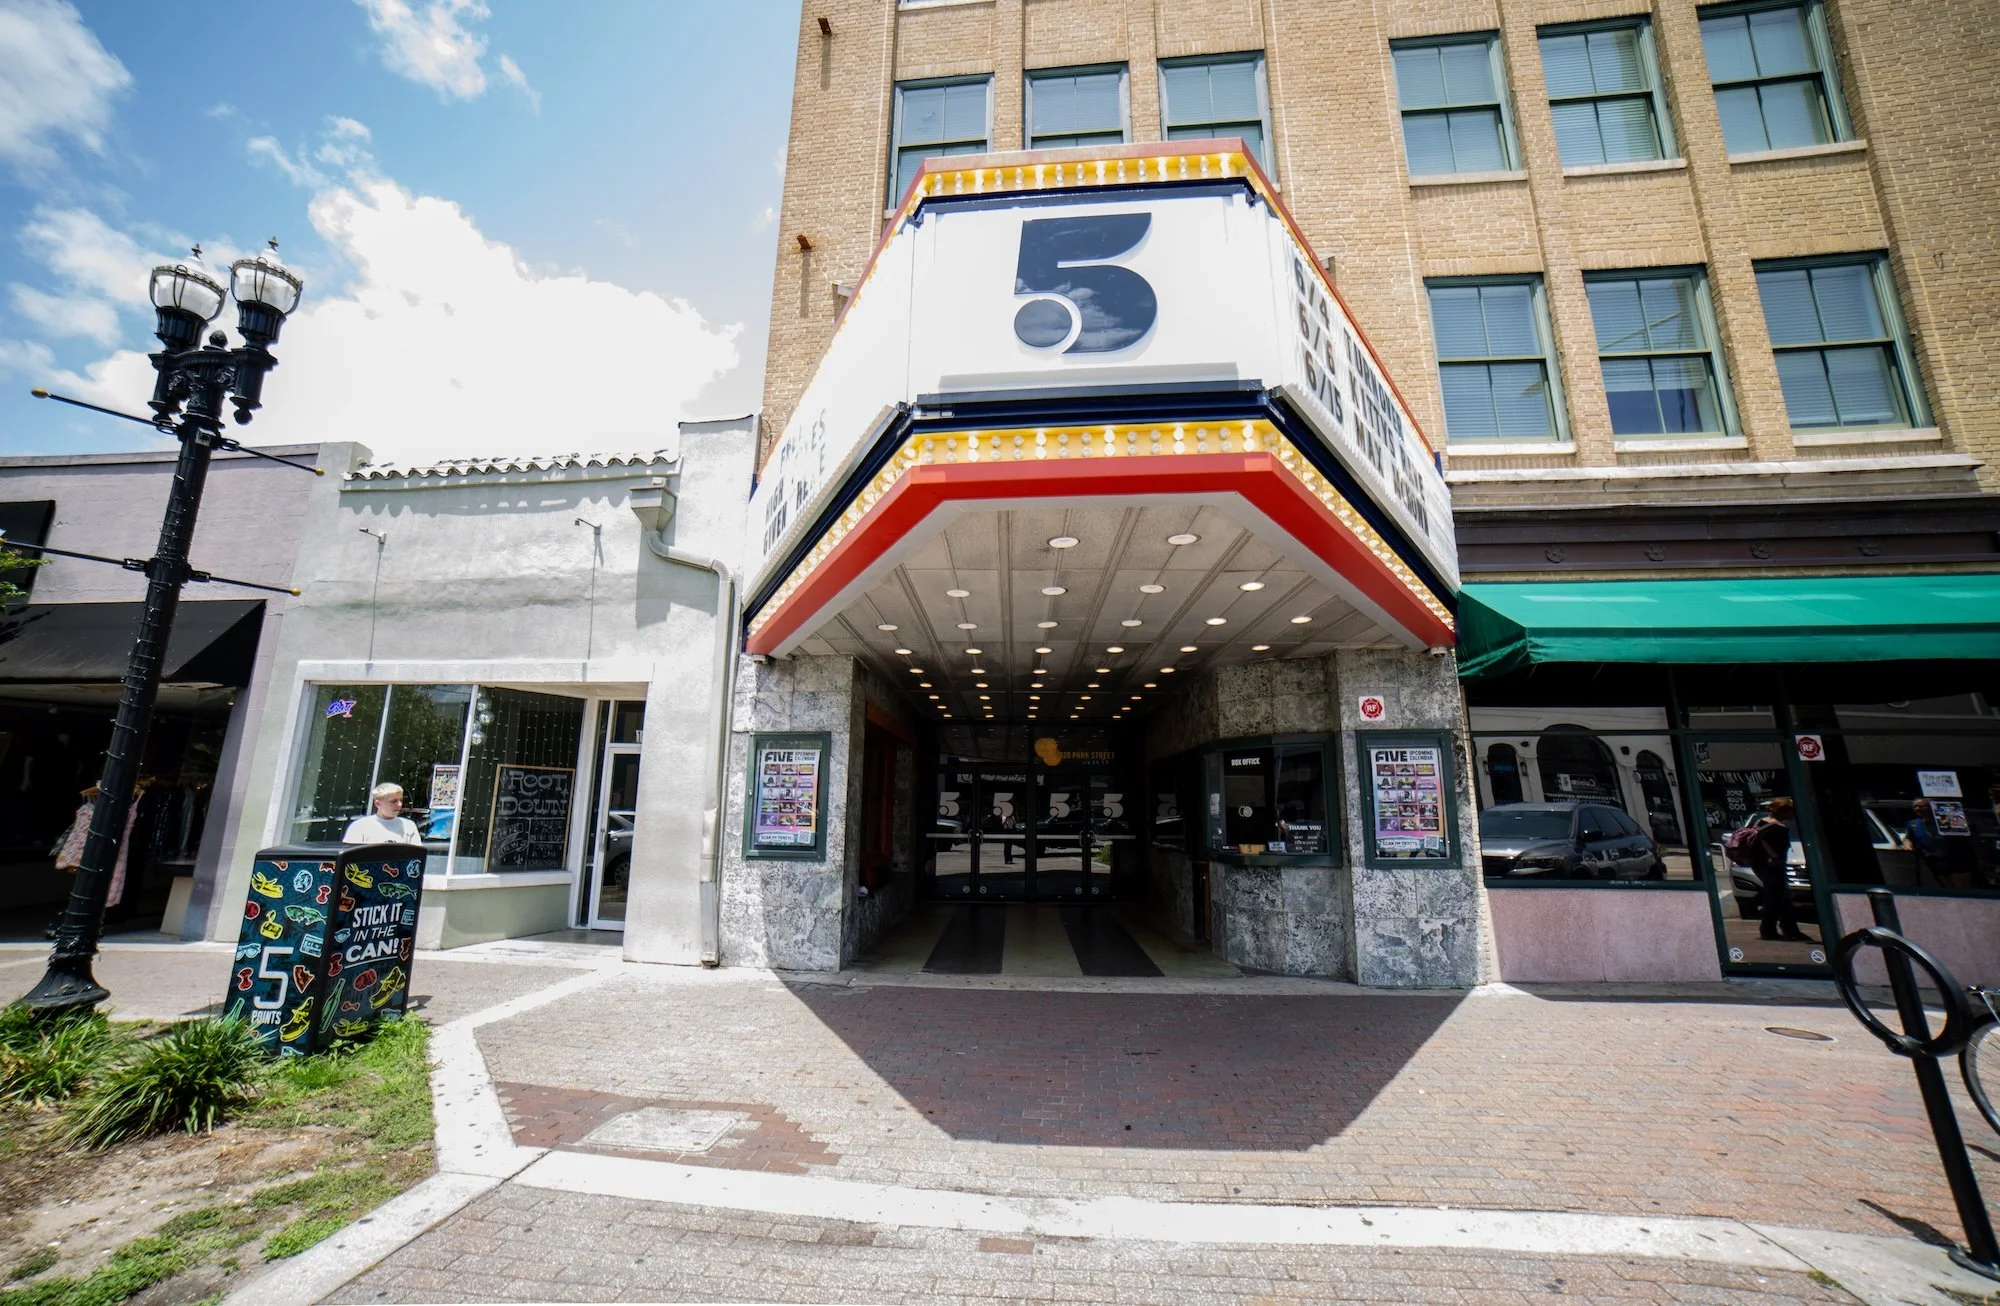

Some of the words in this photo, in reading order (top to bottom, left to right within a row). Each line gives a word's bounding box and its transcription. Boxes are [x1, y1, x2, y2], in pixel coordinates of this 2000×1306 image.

[1014, 212, 1158, 355] 5
[1294, 257, 1330, 331] 6/4
[1343, 327, 1404, 442] TURNOVER
[1299, 302, 1336, 375] 6/6
[1305, 350, 1343, 424] 6/15
[1354, 409, 1385, 480] MAX
[764, 752, 794, 762] FIVE
[1072, 751, 1090, 759] PARK
[1091, 751, 1115, 759] STREET
[1375, 751, 1408, 762] FIVE
[498, 796, 567, 815] DOWN
[939, 791, 960, 817] 5
[993, 792, 1014, 818] 5
[1049, 792, 1070, 818] 5
[1103, 793, 1124, 818] 5
[352, 904, 389, 929] STICK
[390, 902, 403, 922] IT
[353, 928, 369, 942] IN
[371, 924, 397, 940] THE
[345, 937, 400, 963] CAN!
[253, 946, 294, 1010] 5
[250, 1010, 282, 1025] POINTS
